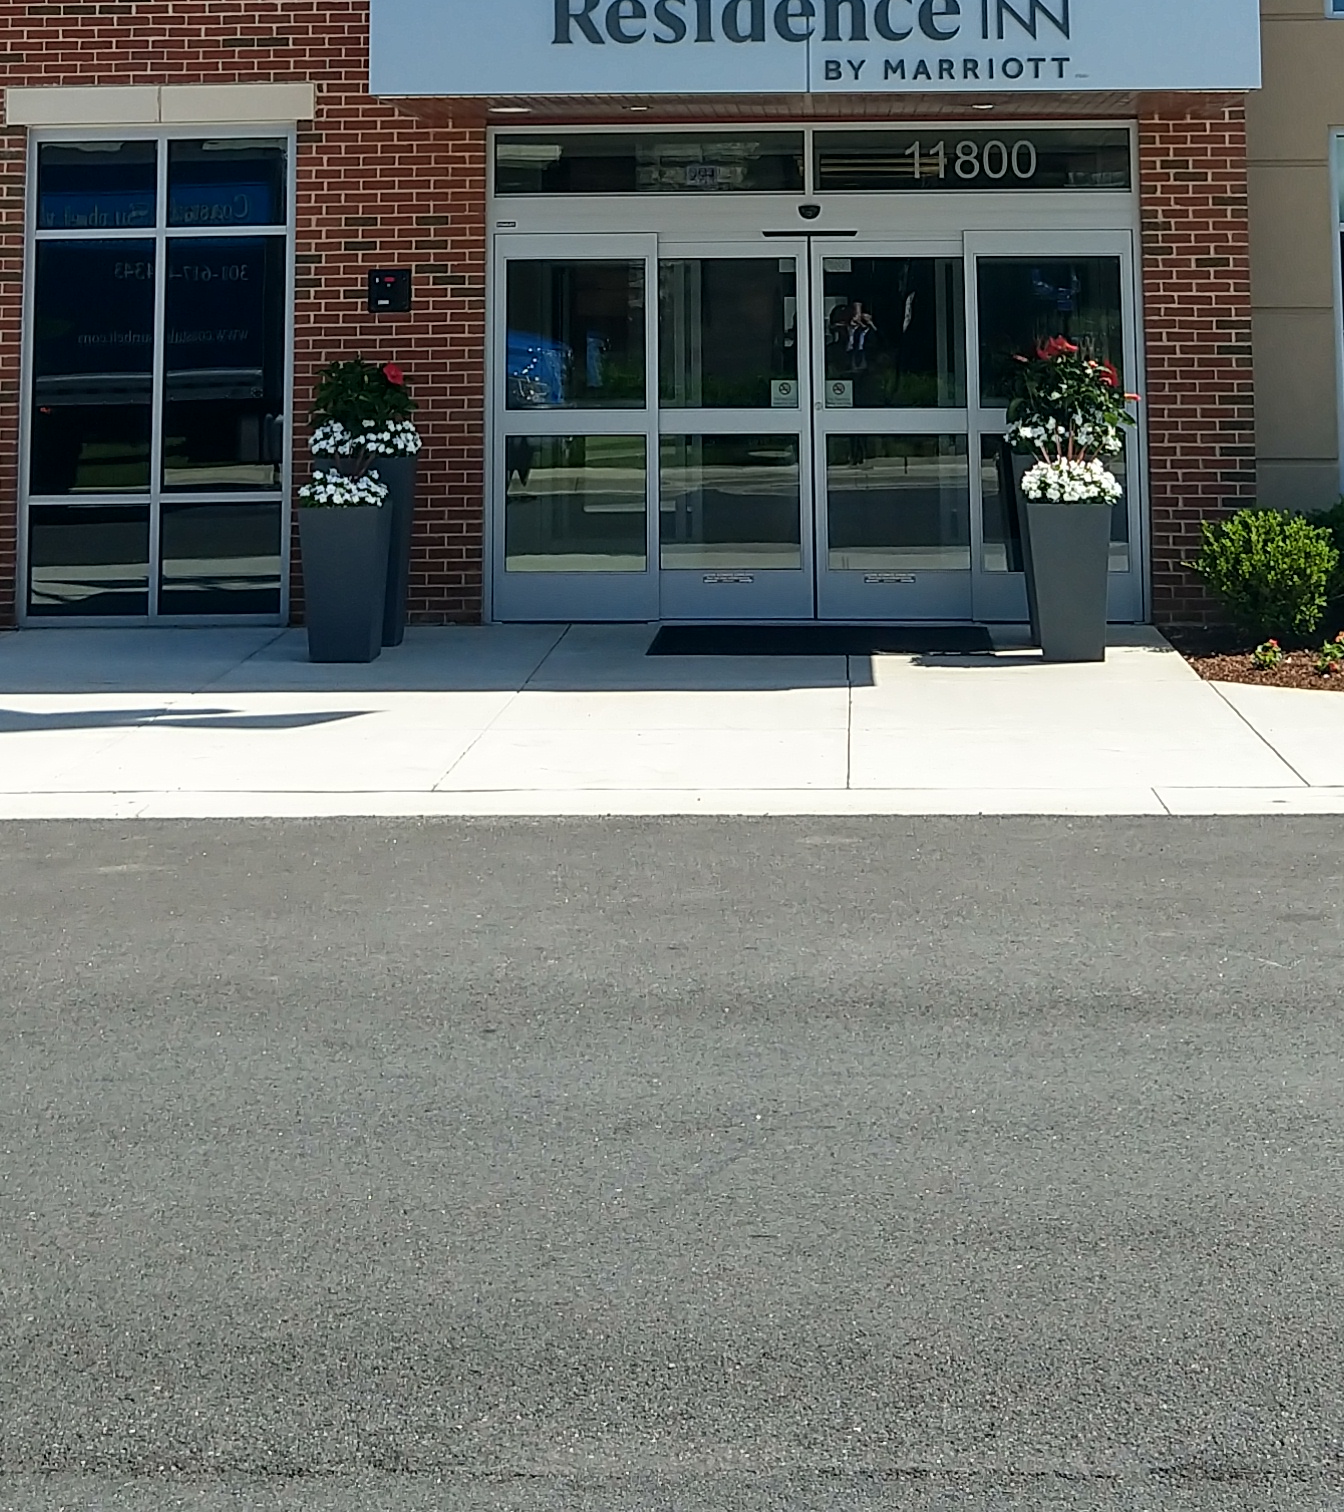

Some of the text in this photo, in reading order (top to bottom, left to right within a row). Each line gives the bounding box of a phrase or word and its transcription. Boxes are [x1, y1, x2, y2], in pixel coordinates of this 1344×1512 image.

[824, 57, 1070, 81] BY MARRIOTT
[905, 140, 1037, 179] 11800
